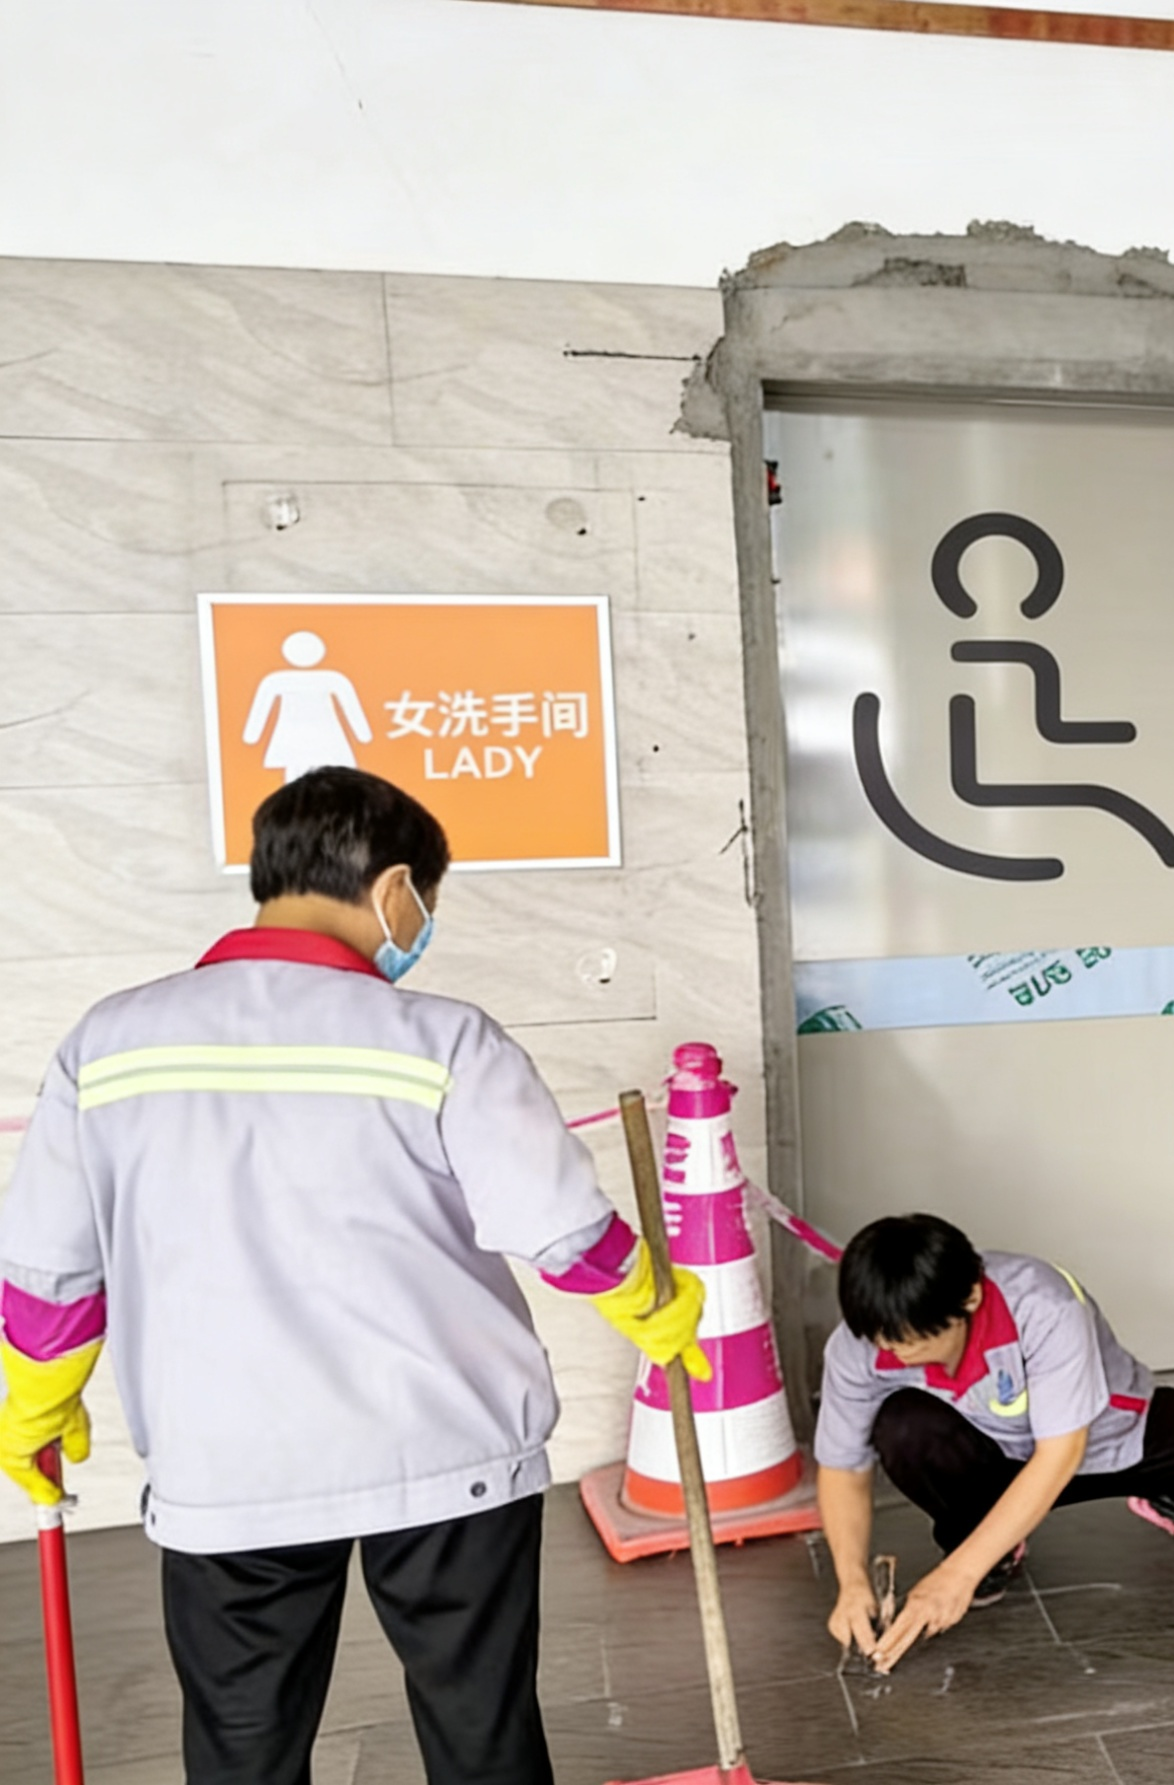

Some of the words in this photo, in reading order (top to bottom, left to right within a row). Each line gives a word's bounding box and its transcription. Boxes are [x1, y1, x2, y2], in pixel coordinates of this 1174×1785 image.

[384, 690, 589, 738] 女洗手间
[424, 746, 542, 779] LADY
